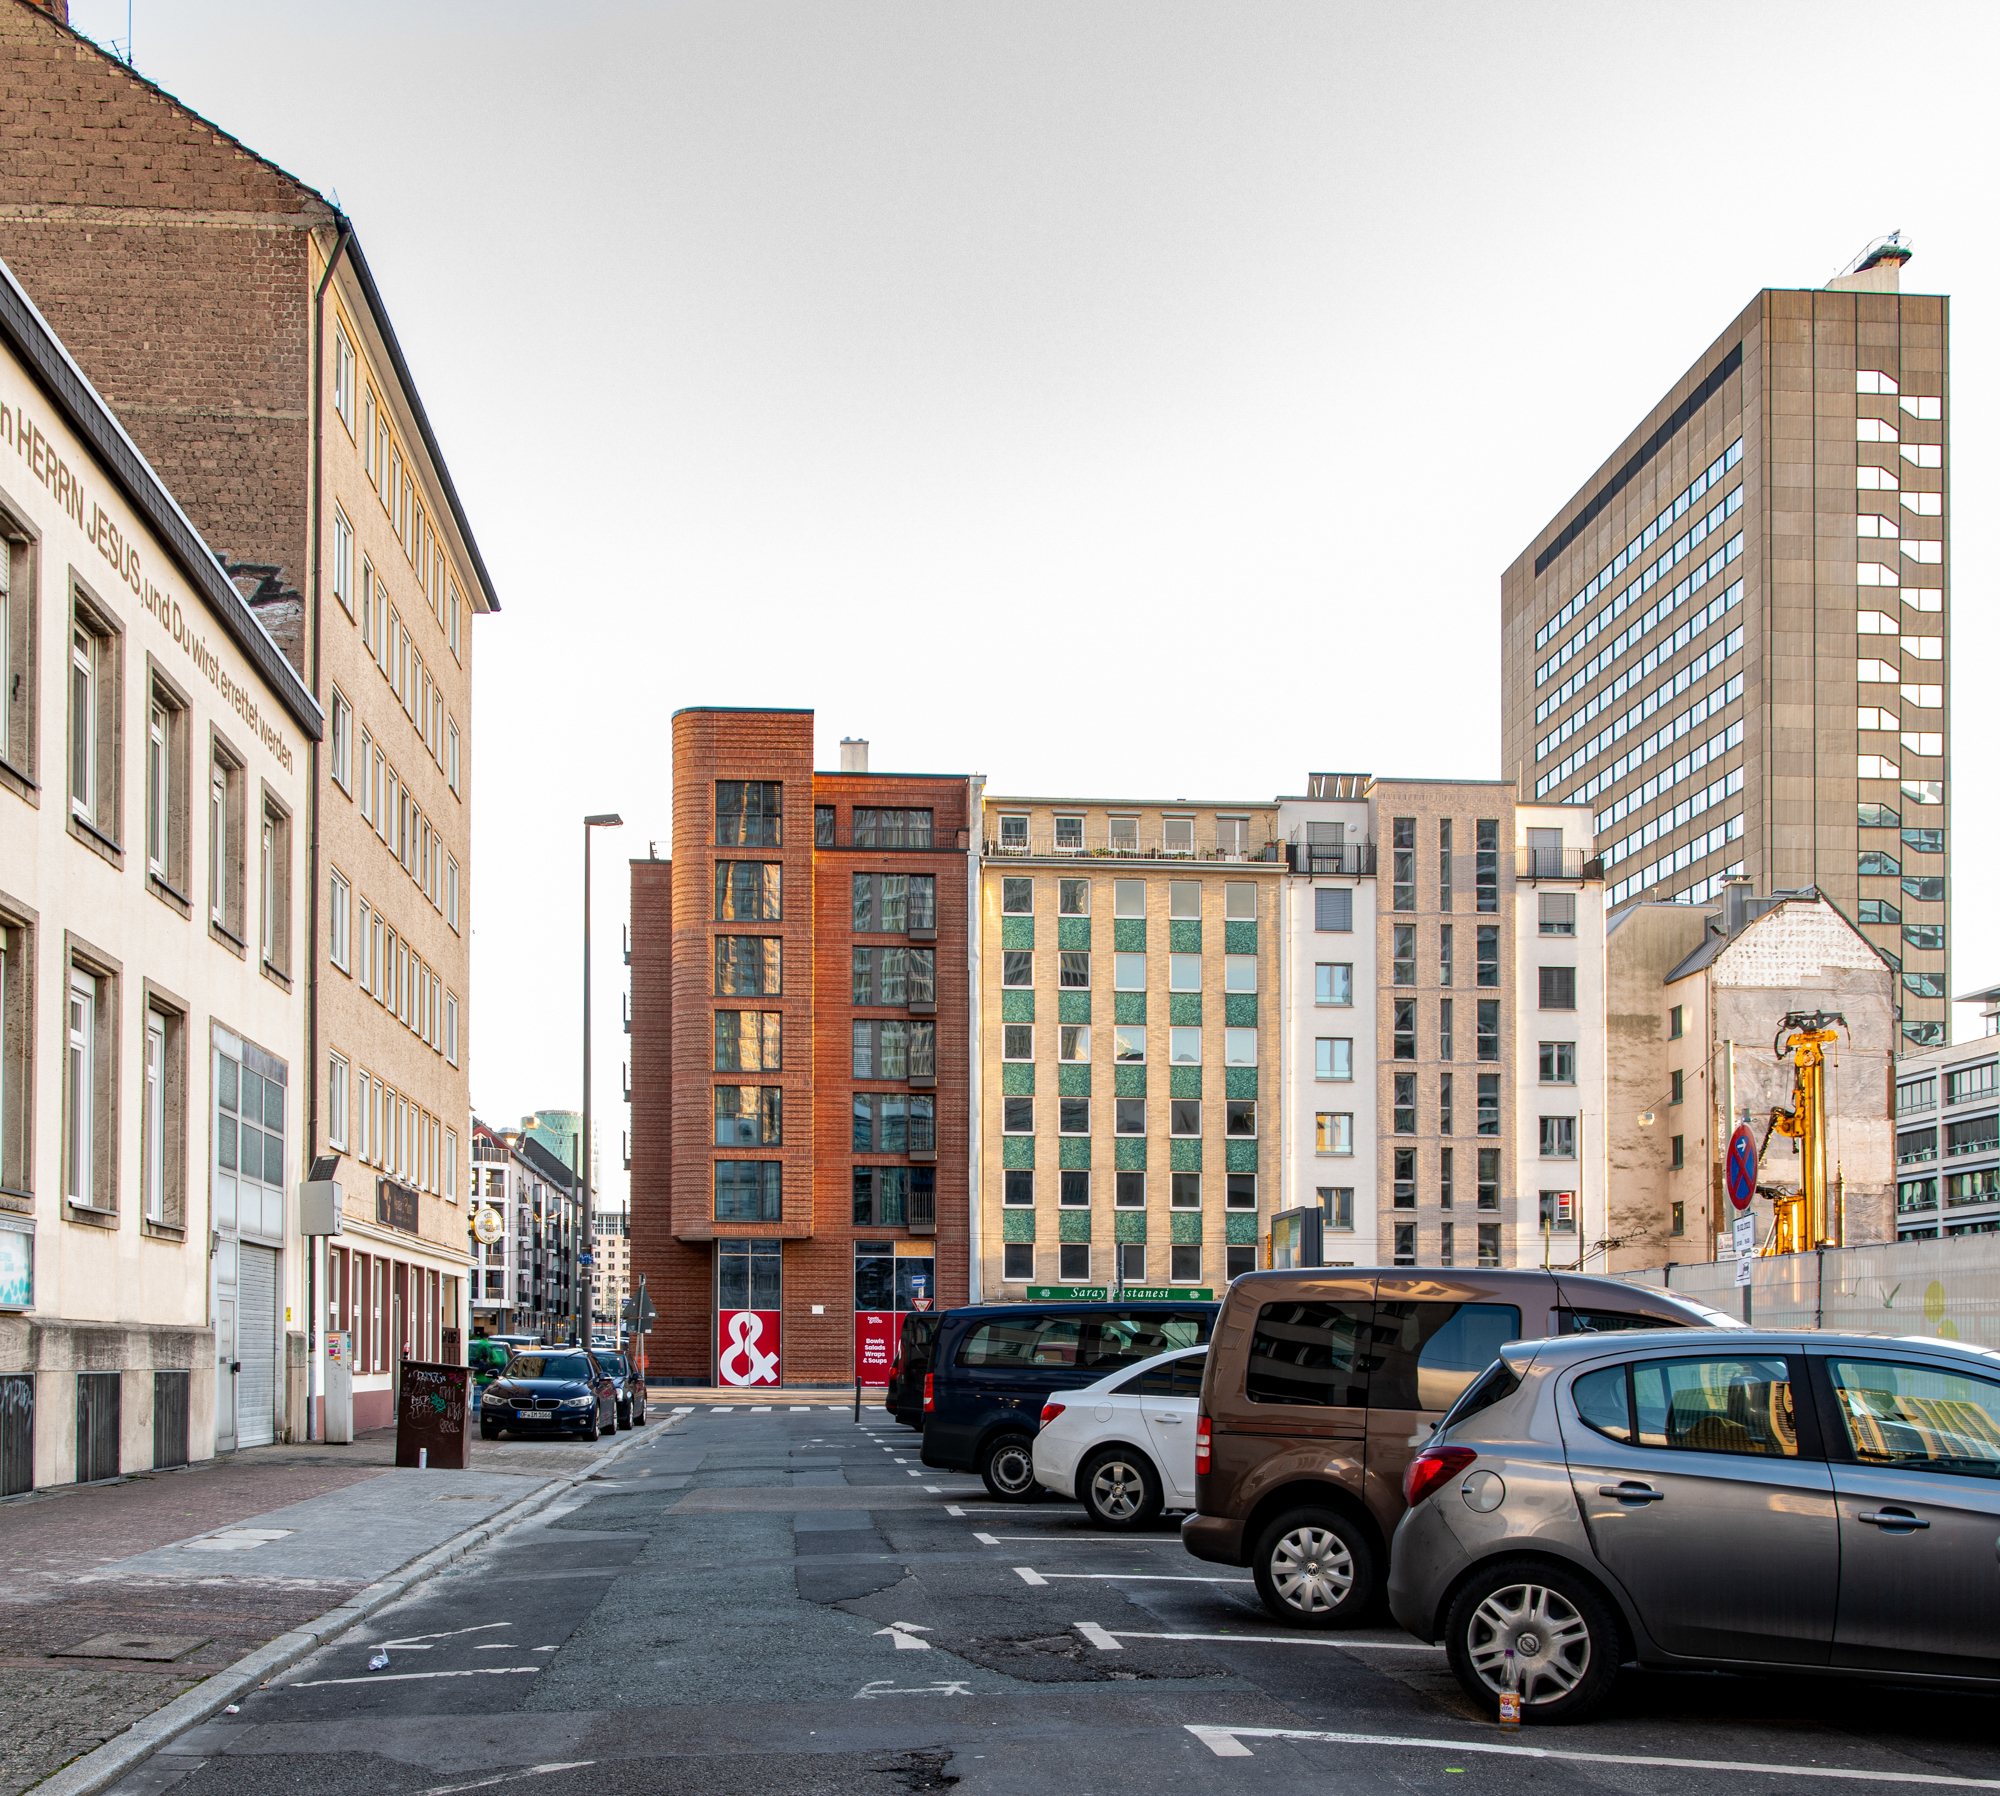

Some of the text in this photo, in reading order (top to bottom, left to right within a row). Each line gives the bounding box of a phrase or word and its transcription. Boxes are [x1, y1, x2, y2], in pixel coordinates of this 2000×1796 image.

[17, 406, 84, 531] HERRN
[145, 578, 170, 632] und
[173, 601, 190, 655] Du
[192, 633, 220, 690] wirst
[221, 671, 259, 736] errettet
[259, 716, 293, 775] werden
[1070, 1287, 1106, 1299] Saray
